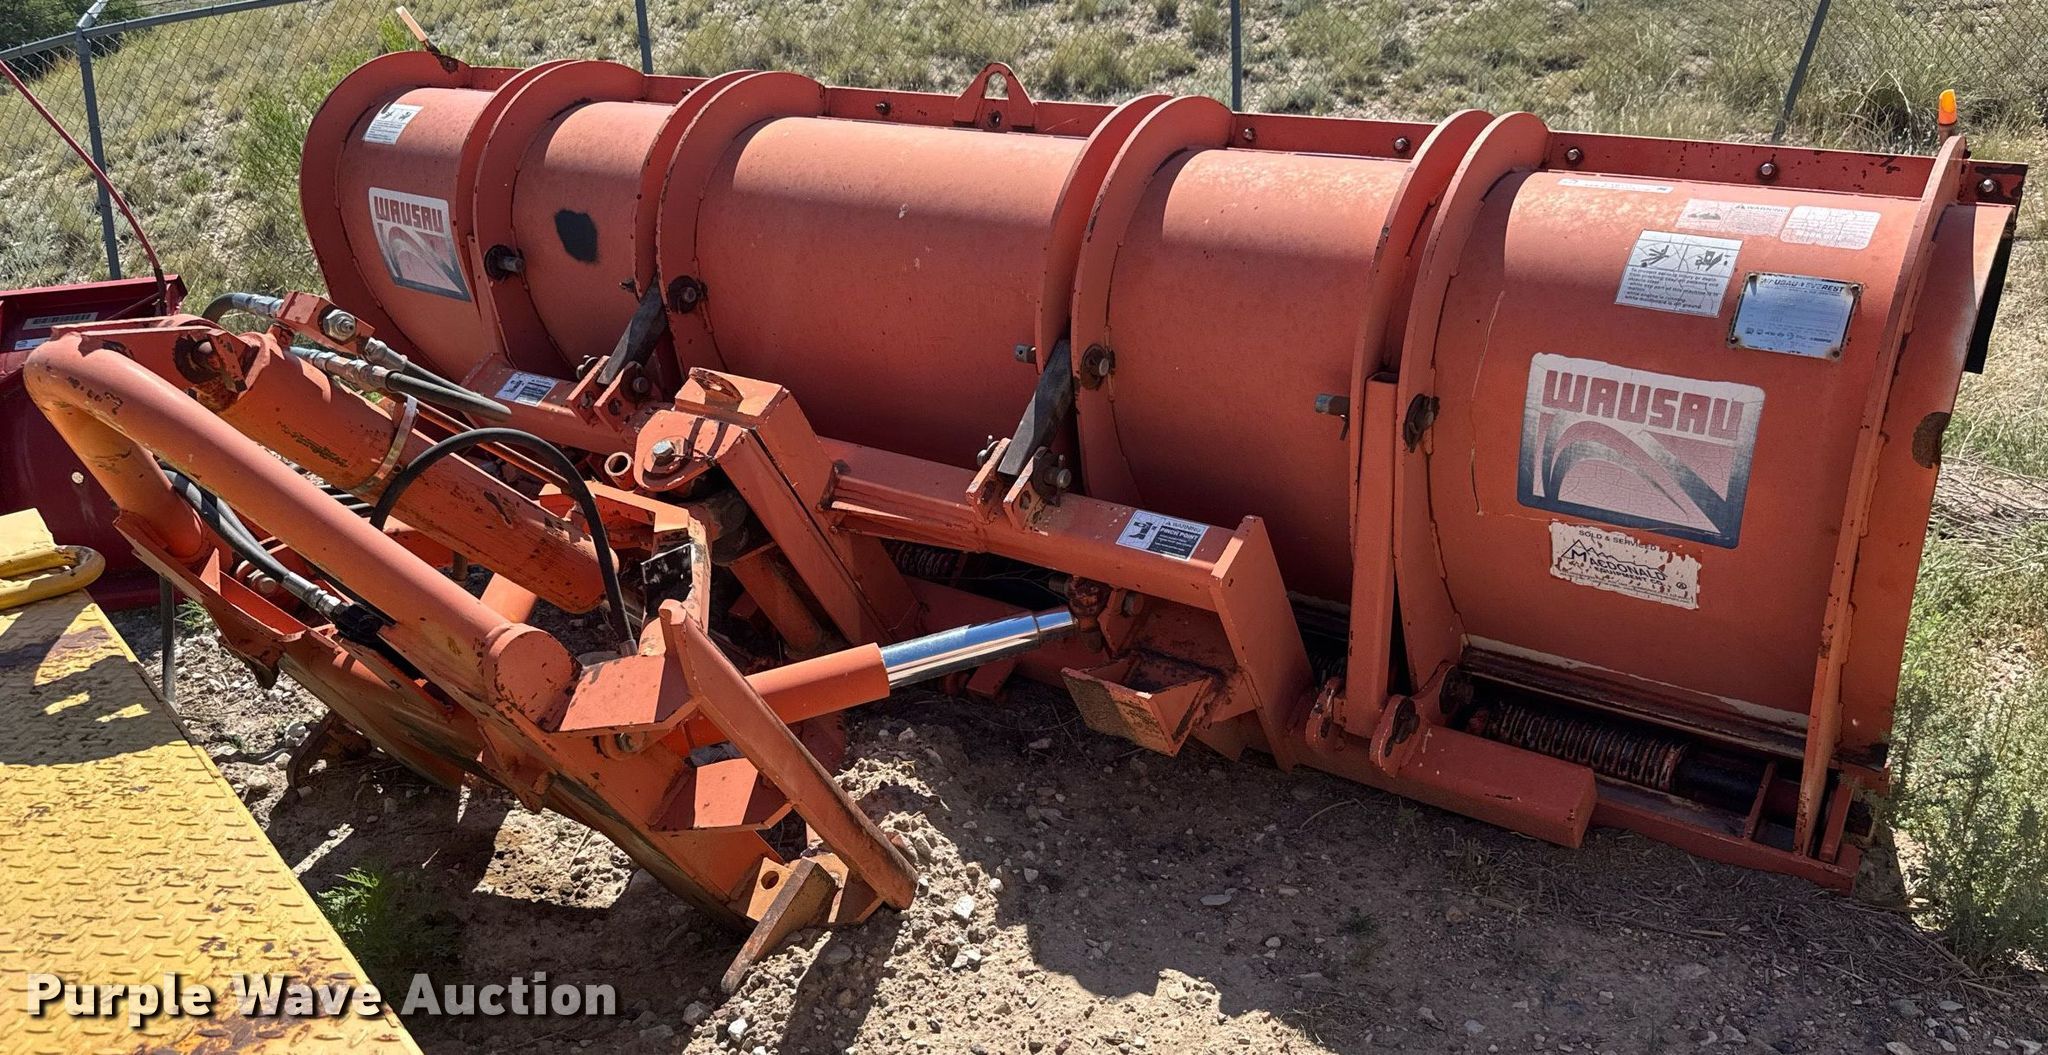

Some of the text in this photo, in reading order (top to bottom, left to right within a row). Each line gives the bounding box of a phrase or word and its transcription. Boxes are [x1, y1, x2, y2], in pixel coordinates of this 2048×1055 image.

[374, 195, 445, 234] WAUSAU
[1541, 369, 1744, 441] WAUSAU
[1160, 527, 1199, 541] PINCH POINT
[1578, 529, 1603, 541] SOLD
[1613, 536, 1657, 551] SERVICED
[1594, 566, 1647, 583] EQUIPMENT
